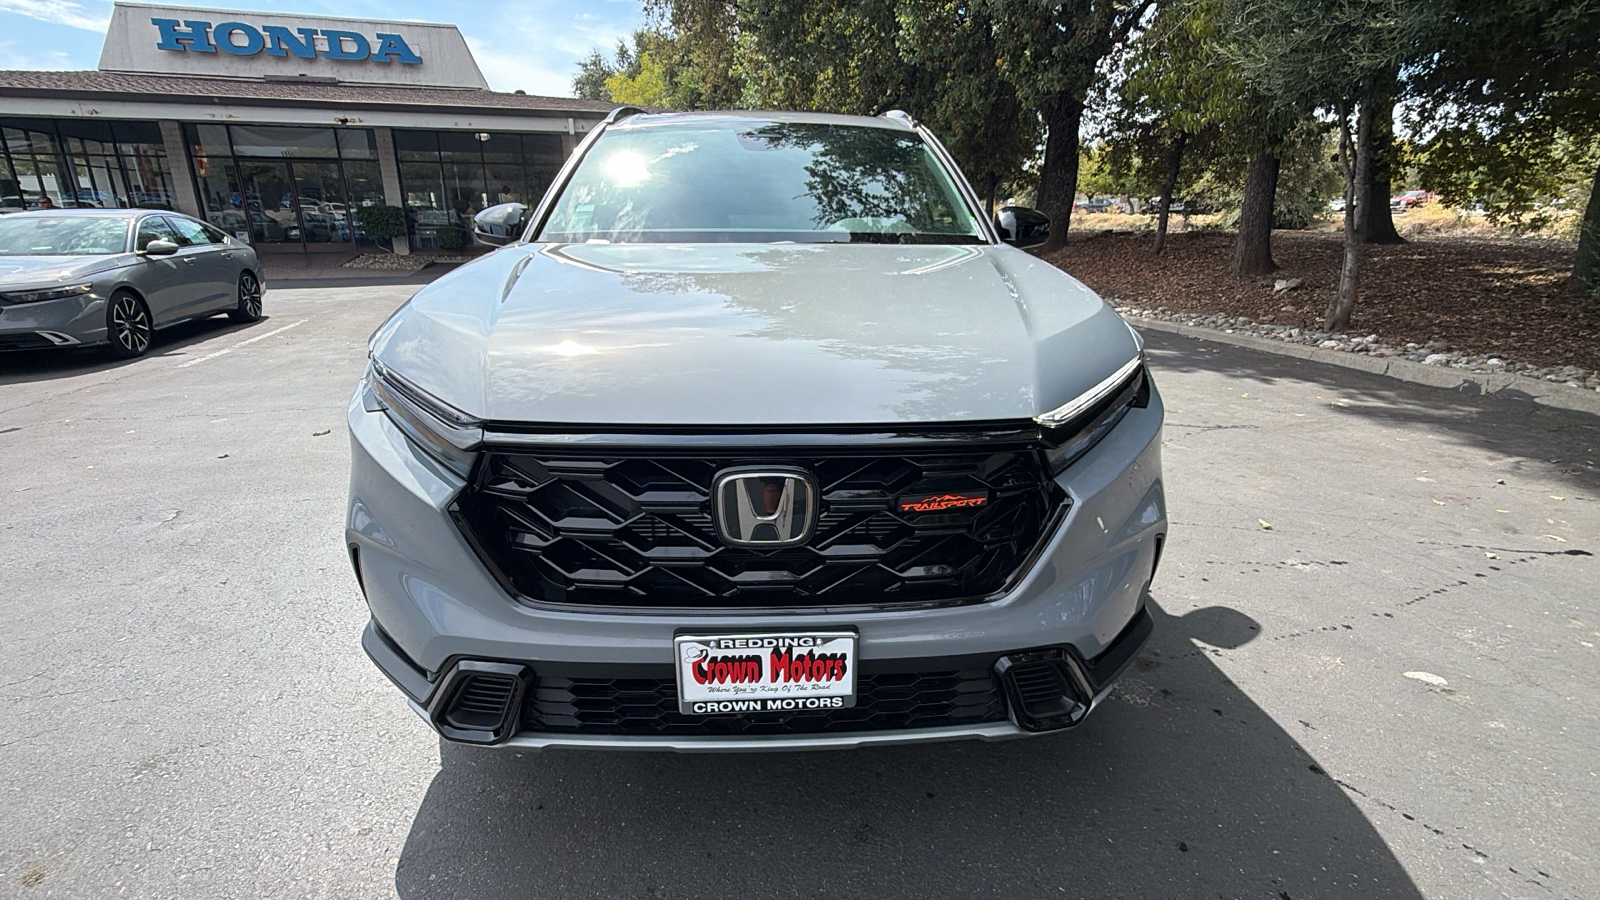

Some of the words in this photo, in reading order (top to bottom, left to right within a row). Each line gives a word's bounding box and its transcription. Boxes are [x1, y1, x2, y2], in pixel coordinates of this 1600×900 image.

[151, 17, 423, 65] HONDA
[901, 497, 987, 512] TRAILSPORT
[720, 638, 814, 649] REDDING
[692, 650, 763, 685] Crown
[770, 647, 847, 683] Motors
[707, 685, 731, 694] Where
[732, 684, 758, 695] You're
[760, 684, 779, 694] King
[781, 684, 792, 693] Of
[794, 683, 808, 692] The
[811, 683, 832, 691] Road
[693, 701, 761, 714] CROWN
[767, 697, 843, 711] MOTORS
